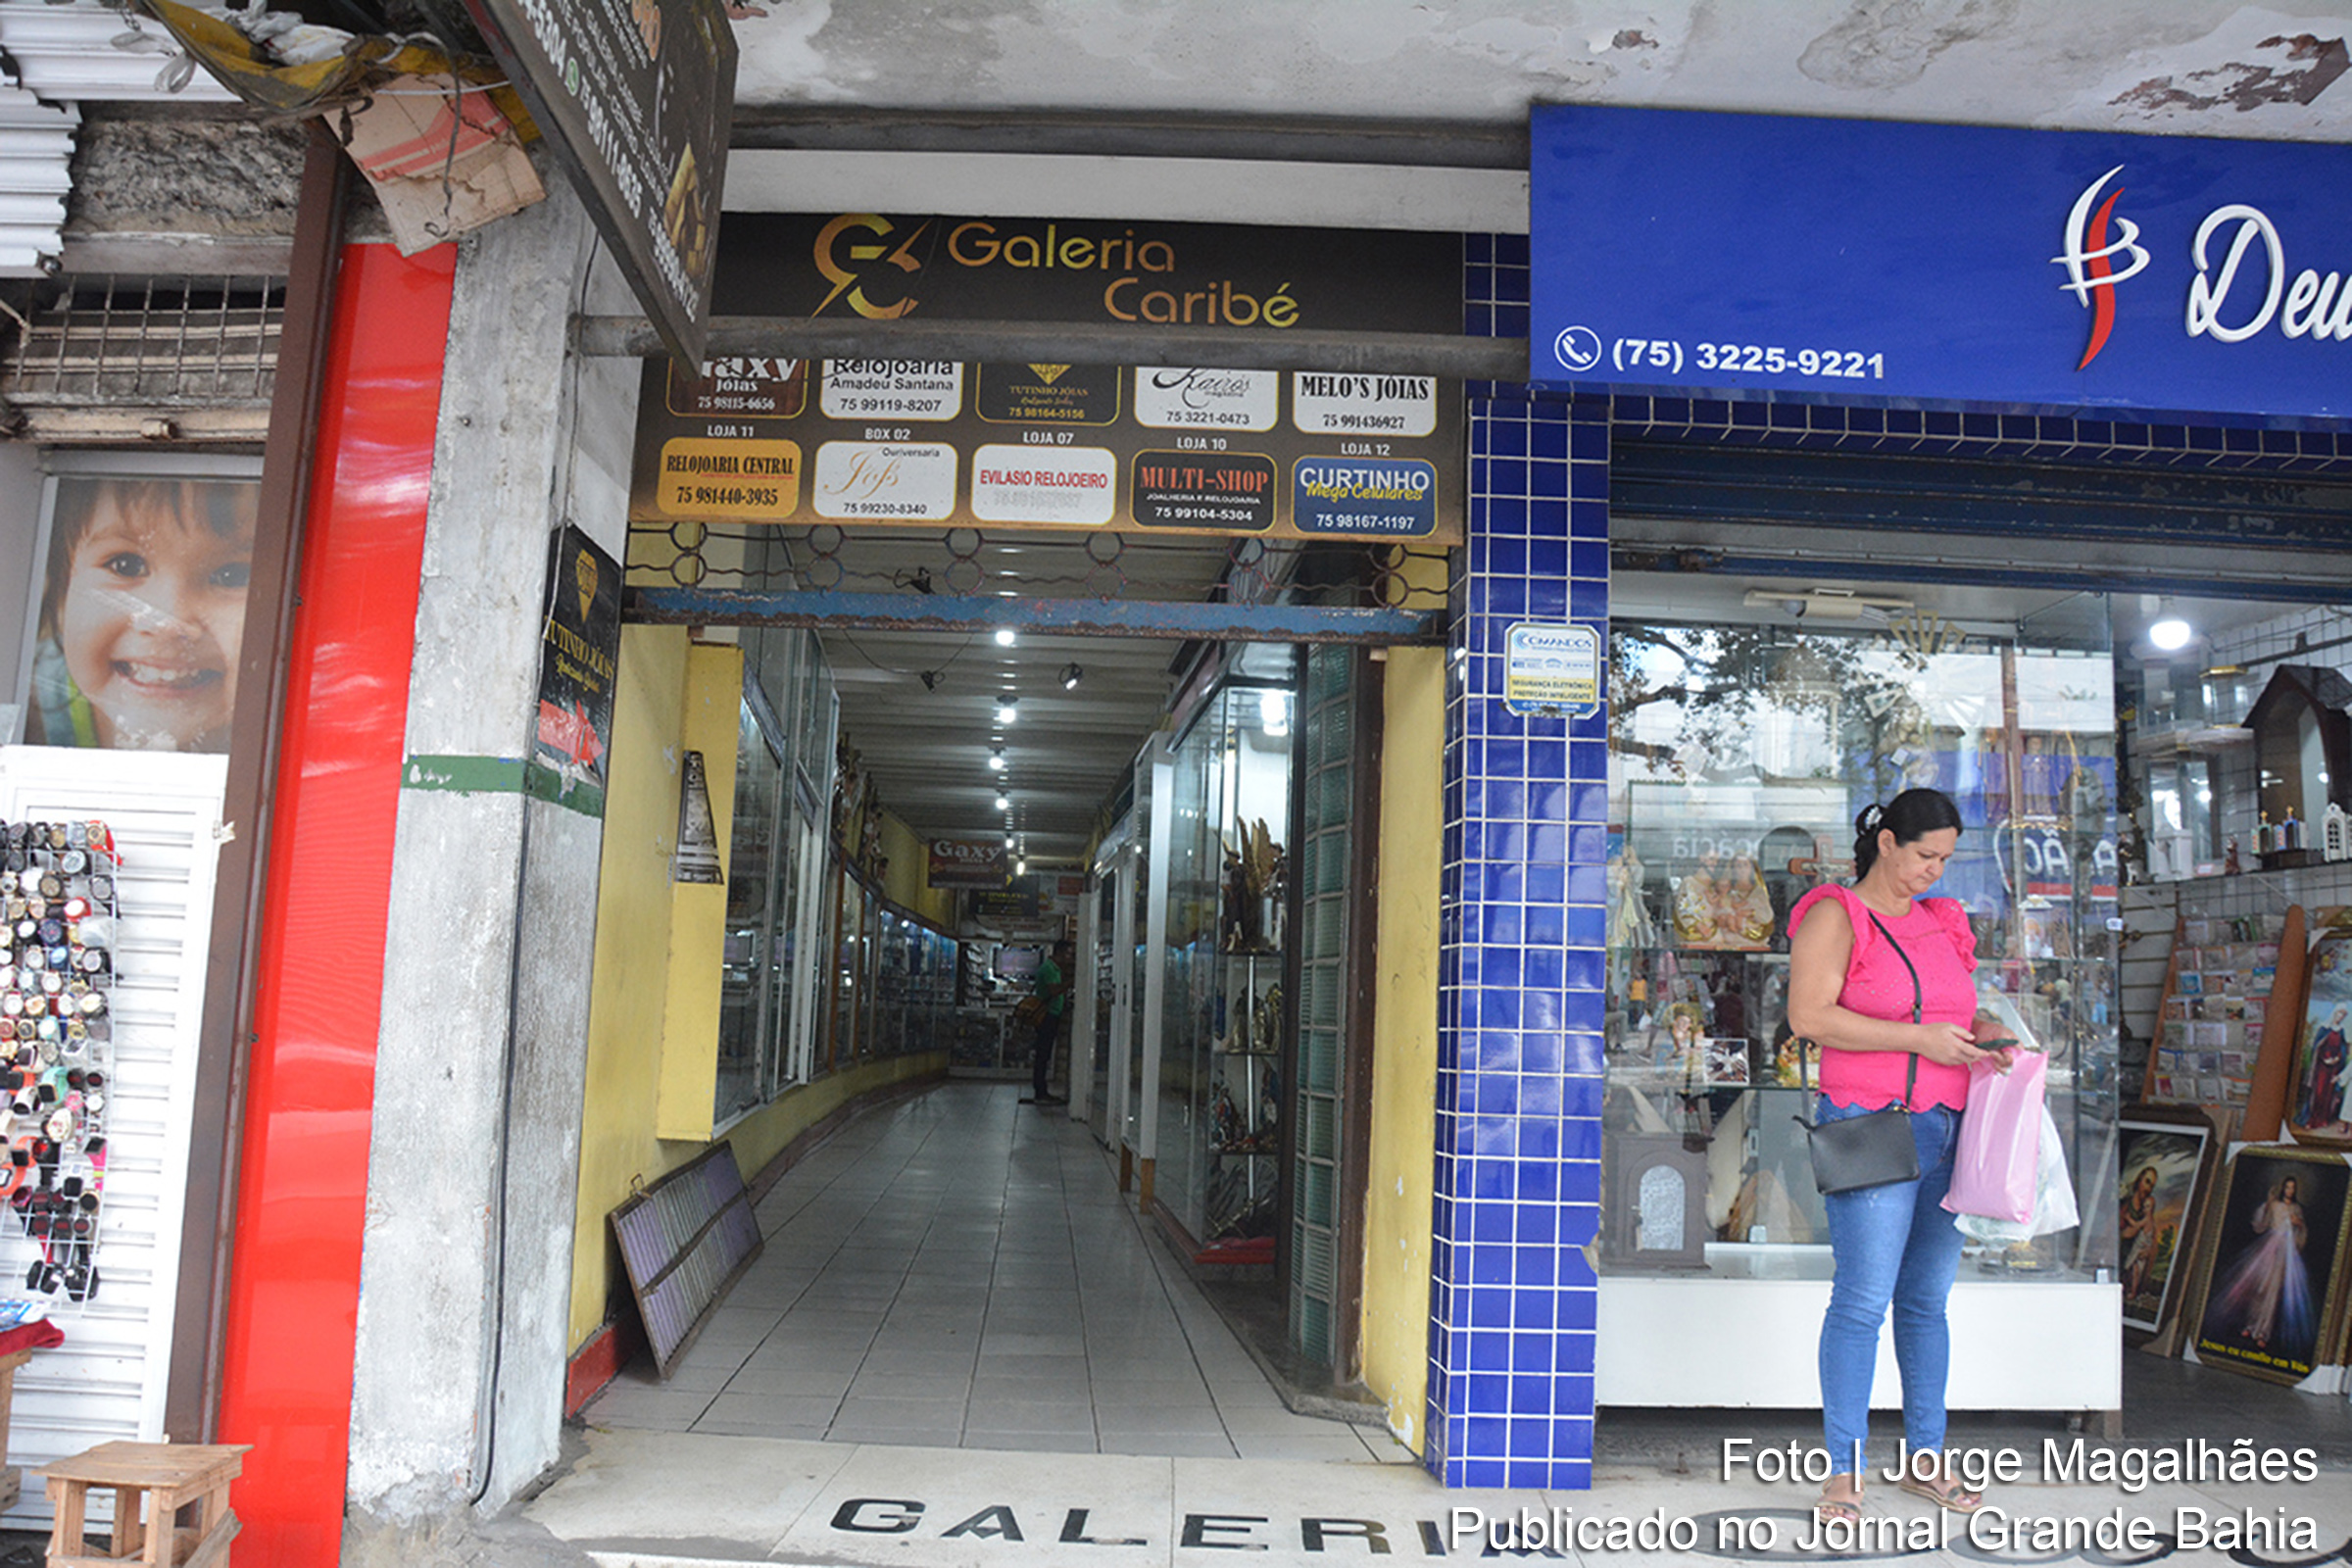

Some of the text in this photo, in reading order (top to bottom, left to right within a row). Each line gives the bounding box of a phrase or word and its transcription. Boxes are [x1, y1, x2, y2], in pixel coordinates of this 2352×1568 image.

[948, 221, 1175, 271] Galeria
[1103, 277, 1299, 327] Caribé
[1612, 338, 1885, 379] (75) 3225-9221
[702, 358, 798, 382] axy
[830, 377, 954, 391] Amadeu Santana
[1301, 375, 1370, 399] MELO'S
[698, 396, 711, 409] 75
[840, 398, 942, 412] 75 99119-8207
[1008, 407, 1021, 416] 75
[1166, 411, 1250, 425] 75 3221-0473
[1323, 414, 1405, 429] 75 991436927
[707, 424, 754, 437] LOJA 11
[864, 427, 910, 440] BOX 02
[1023, 431, 1074, 444] LOJA 07
[1177, 437, 1227, 450] LOJA 10
[1341, 443, 1391, 456] LOJA 12
[666, 455, 795, 475] RELOJOARIA CENTRAL
[980, 469, 1108, 488] EVILASIO RELOJOEIRO
[1140, 466, 1269, 493] MULTI-SHOP
[1299, 467, 1430, 492] CURTINHO
[676, 485, 779, 506] 75 981440-3935
[1147, 492, 1195, 502] JOALHERIA
[1204, 494, 1261, 505] RELOJOARIA
[1306, 481, 1424, 503] Mega Celulares
[844, 503, 858, 514] 75
[1155, 507, 1253, 521] 75 99104-5304
[1316, 514, 1415, 529] 75 98167-1197
[934, 840, 1002, 862] Gaxy
[2199, 1339, 2227, 1352] Jesus
